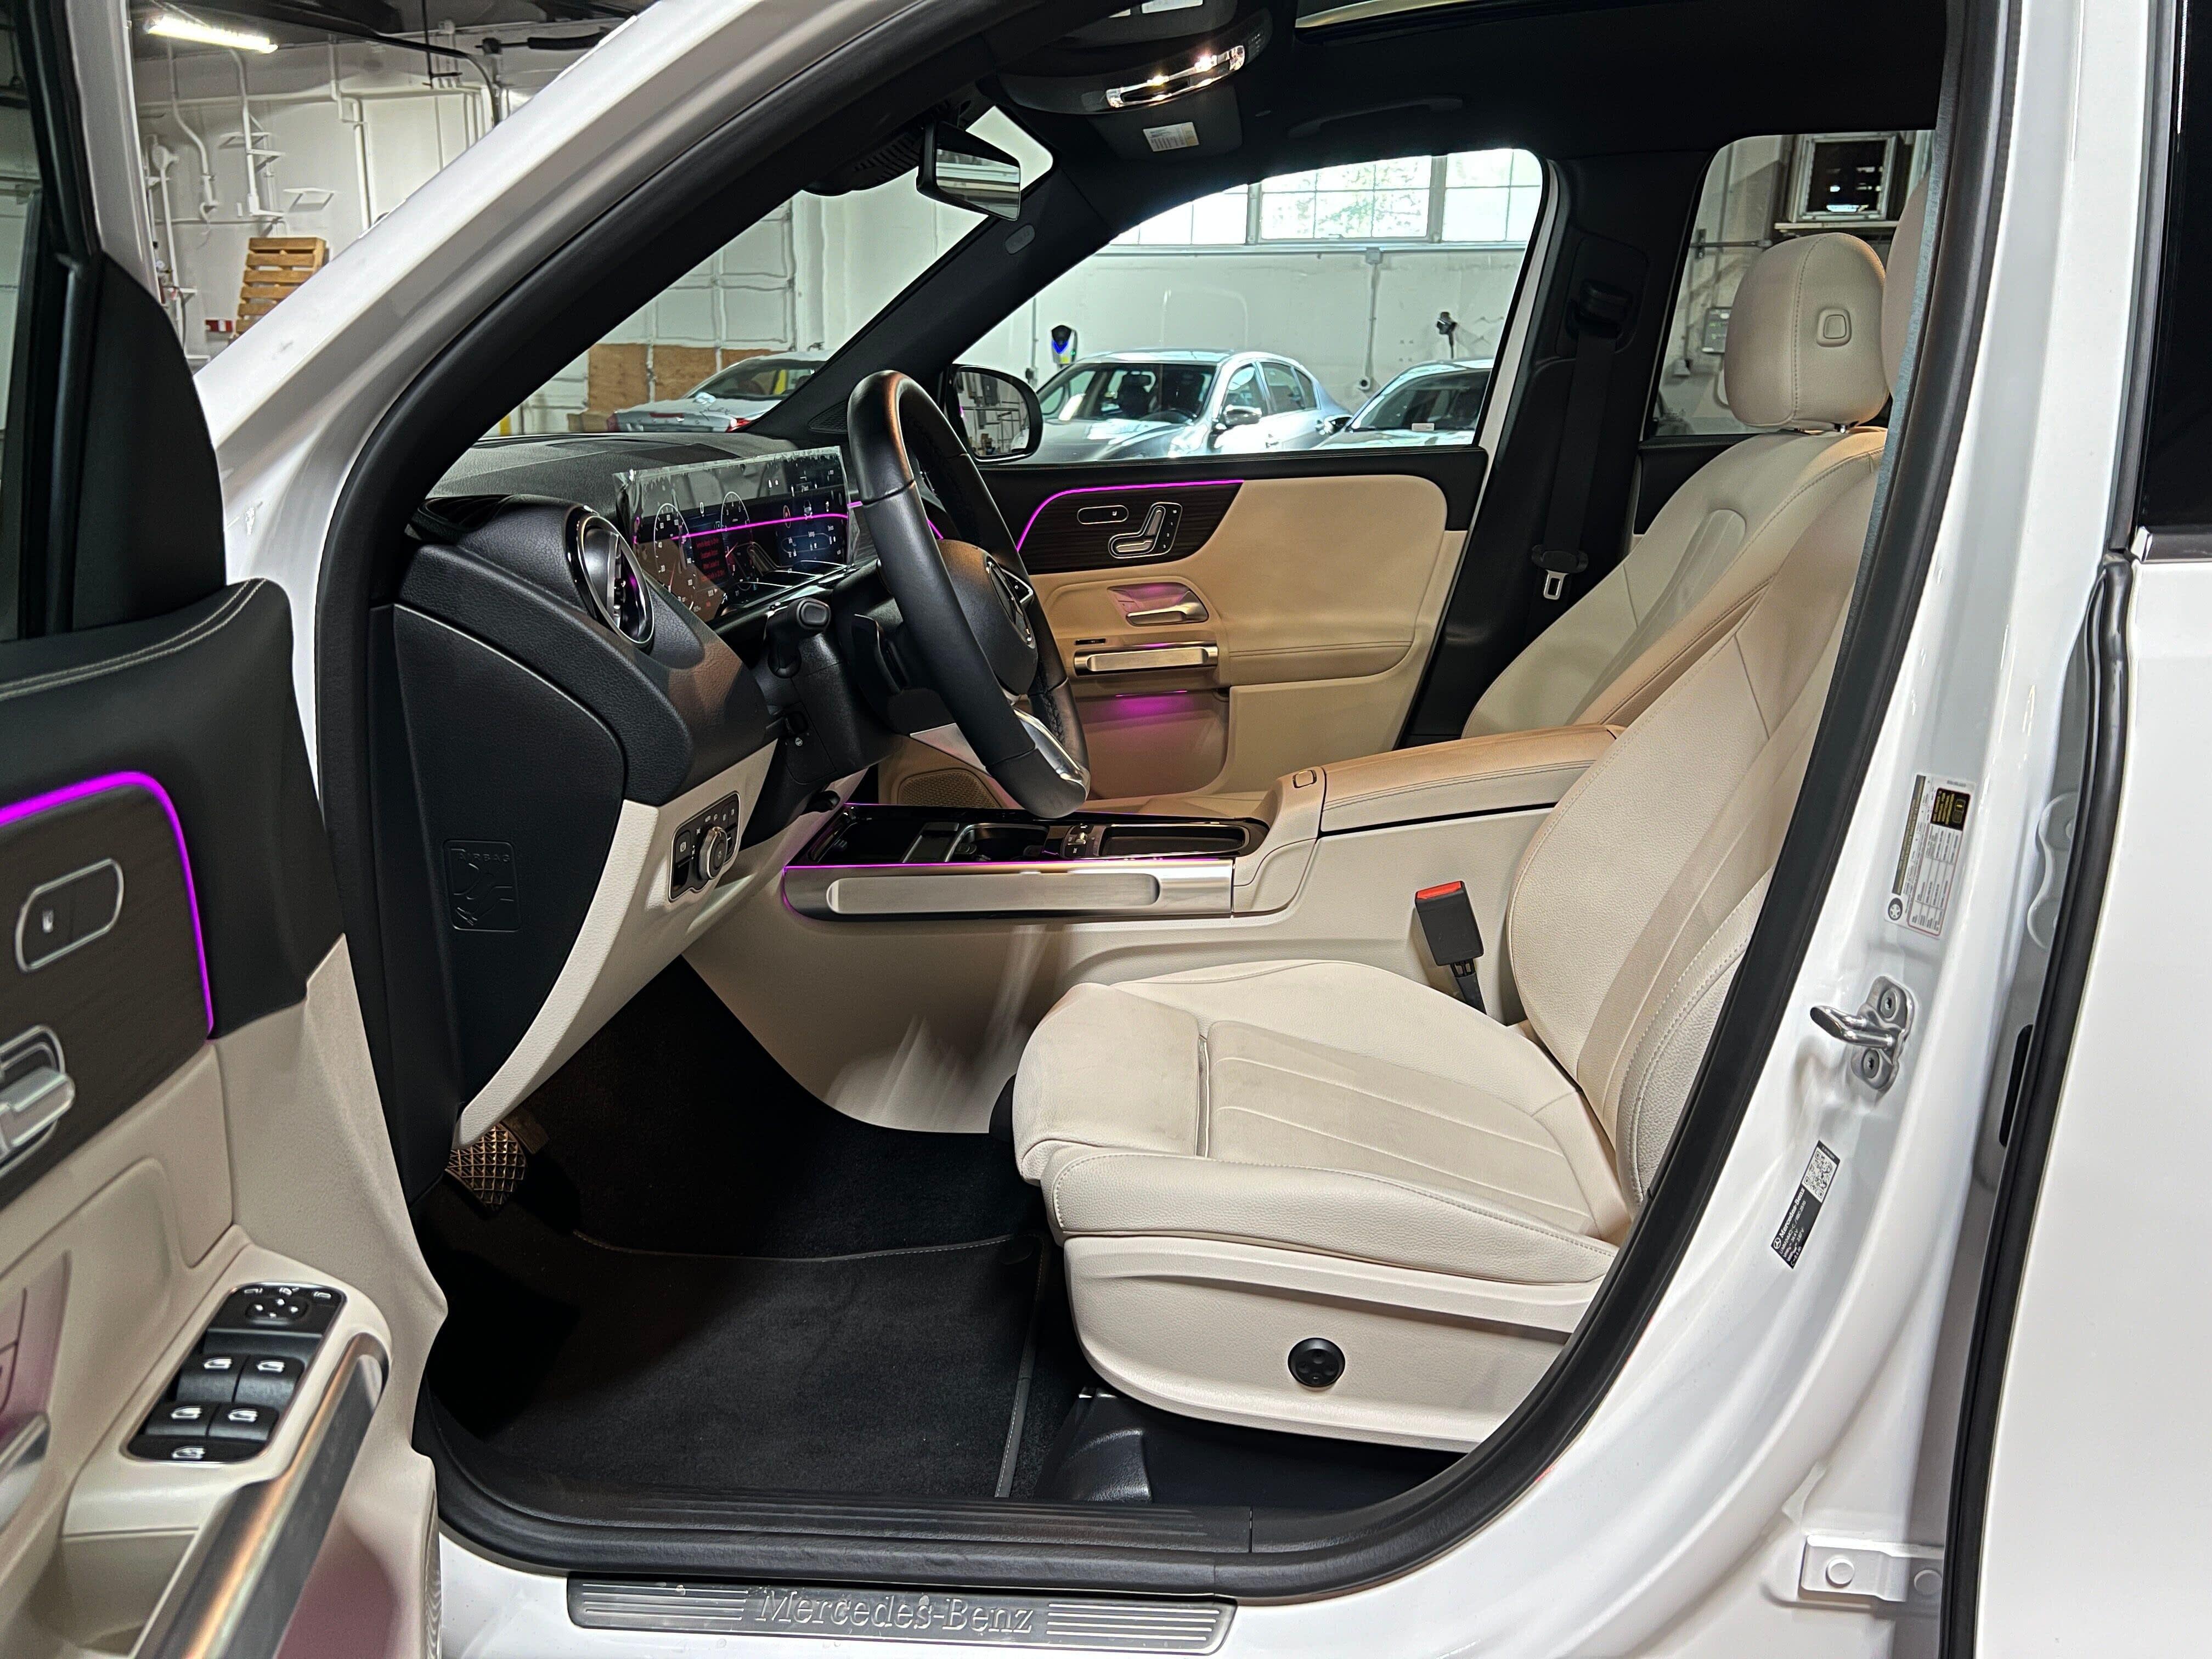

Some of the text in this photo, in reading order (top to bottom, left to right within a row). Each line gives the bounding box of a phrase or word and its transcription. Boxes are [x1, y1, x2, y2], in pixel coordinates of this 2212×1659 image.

[458, 853, 511, 862] AIRBAG
[1779, 1187, 1805, 1238] Mercedes-Benz
[755, 1589, 1034, 1633] Mercedes-Benz
